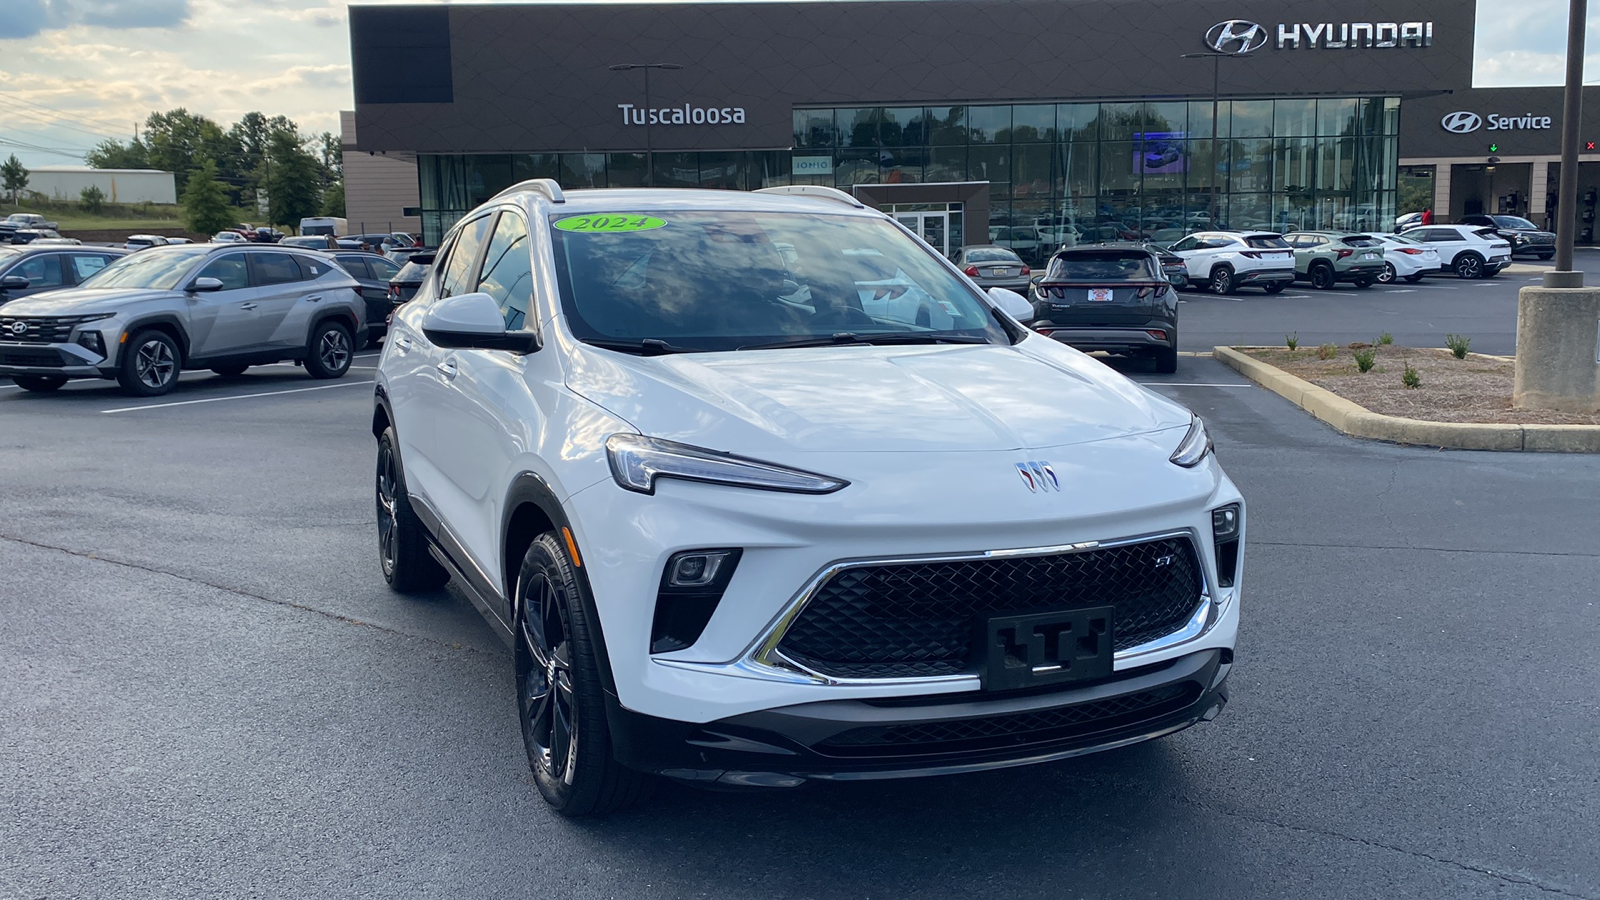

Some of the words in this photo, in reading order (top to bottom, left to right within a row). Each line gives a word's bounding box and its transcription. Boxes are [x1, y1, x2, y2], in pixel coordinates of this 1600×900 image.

[1278, 22, 1433, 49] HYUNDAI
[617, 103, 746, 125] Tuscaloosa
[1487, 112, 1552, 130] Service
[573, 217, 649, 230] 2024
